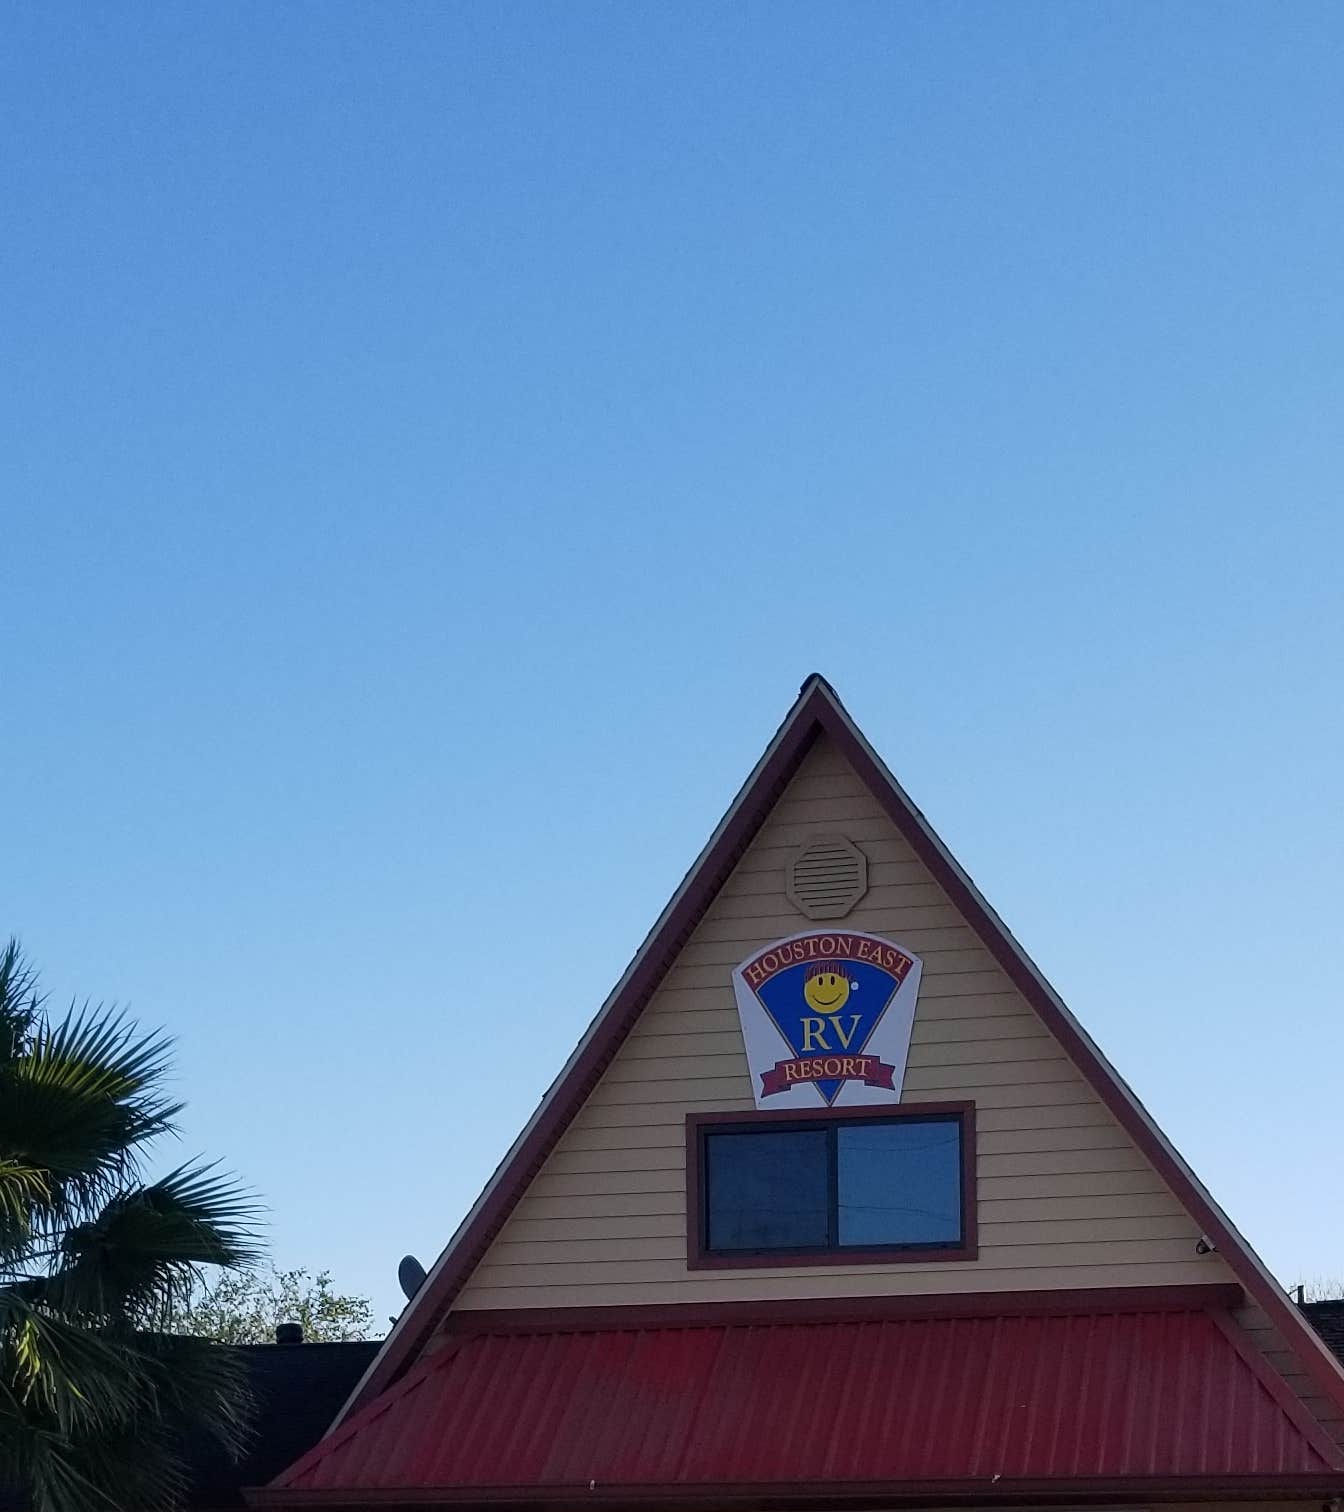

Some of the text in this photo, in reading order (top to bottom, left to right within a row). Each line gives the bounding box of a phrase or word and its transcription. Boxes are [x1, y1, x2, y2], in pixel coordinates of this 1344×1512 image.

[747, 936, 914, 984] HOUSTON EAST
[799, 1014, 864, 1052] RV
[783, 1058, 872, 1081] RESORT
